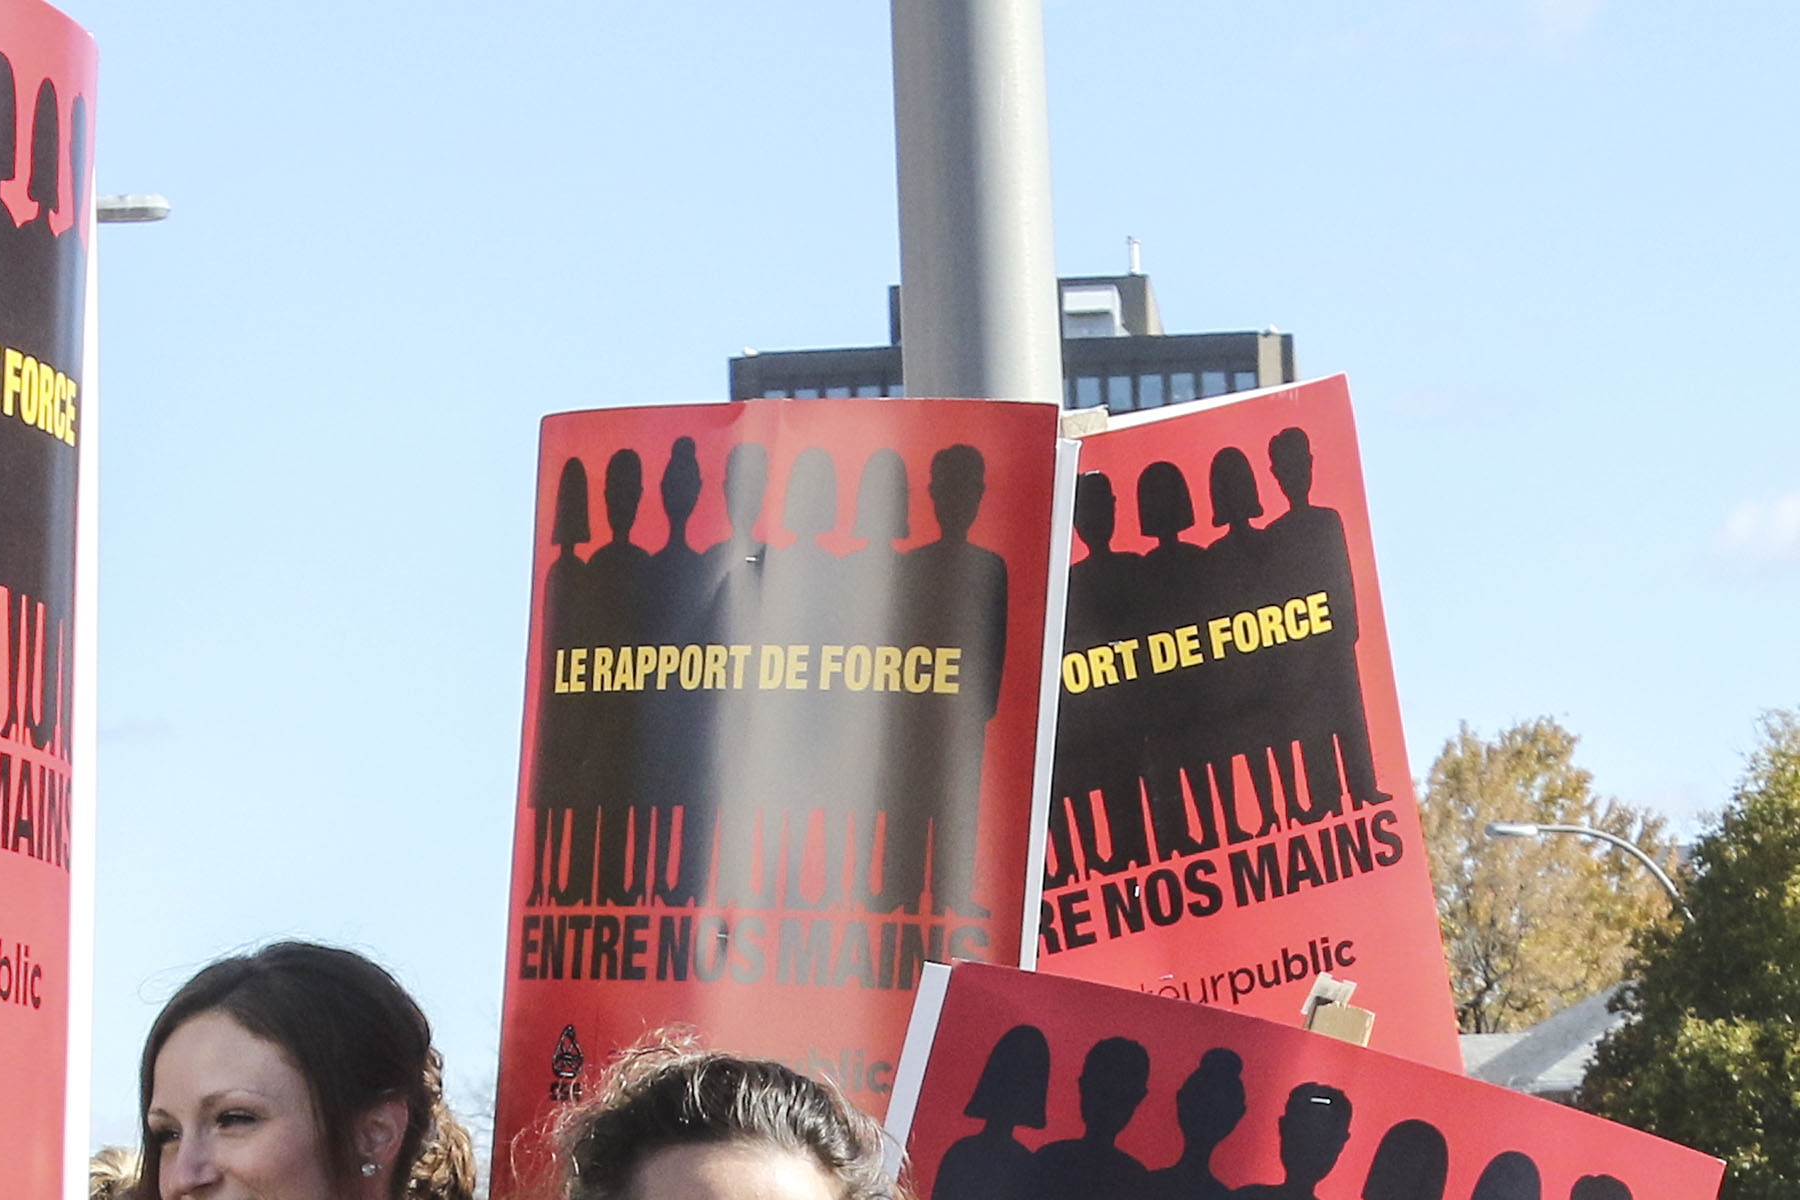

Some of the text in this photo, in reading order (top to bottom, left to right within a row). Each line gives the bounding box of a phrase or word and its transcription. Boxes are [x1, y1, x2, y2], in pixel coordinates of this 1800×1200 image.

[2, 347, 78, 448] FORCE
[554, 643, 961, 695] LE RAPPORT DE FORCE
[1147, 624, 1203, 674] DE
[1208, 592, 1333, 660] FORCE
[1101, 859, 1223, 939] NOS
[1228, 810, 1403, 907] MAINS
[519, 914, 650, 981] ENTRE
[656, 914, 767, 984] NOS
